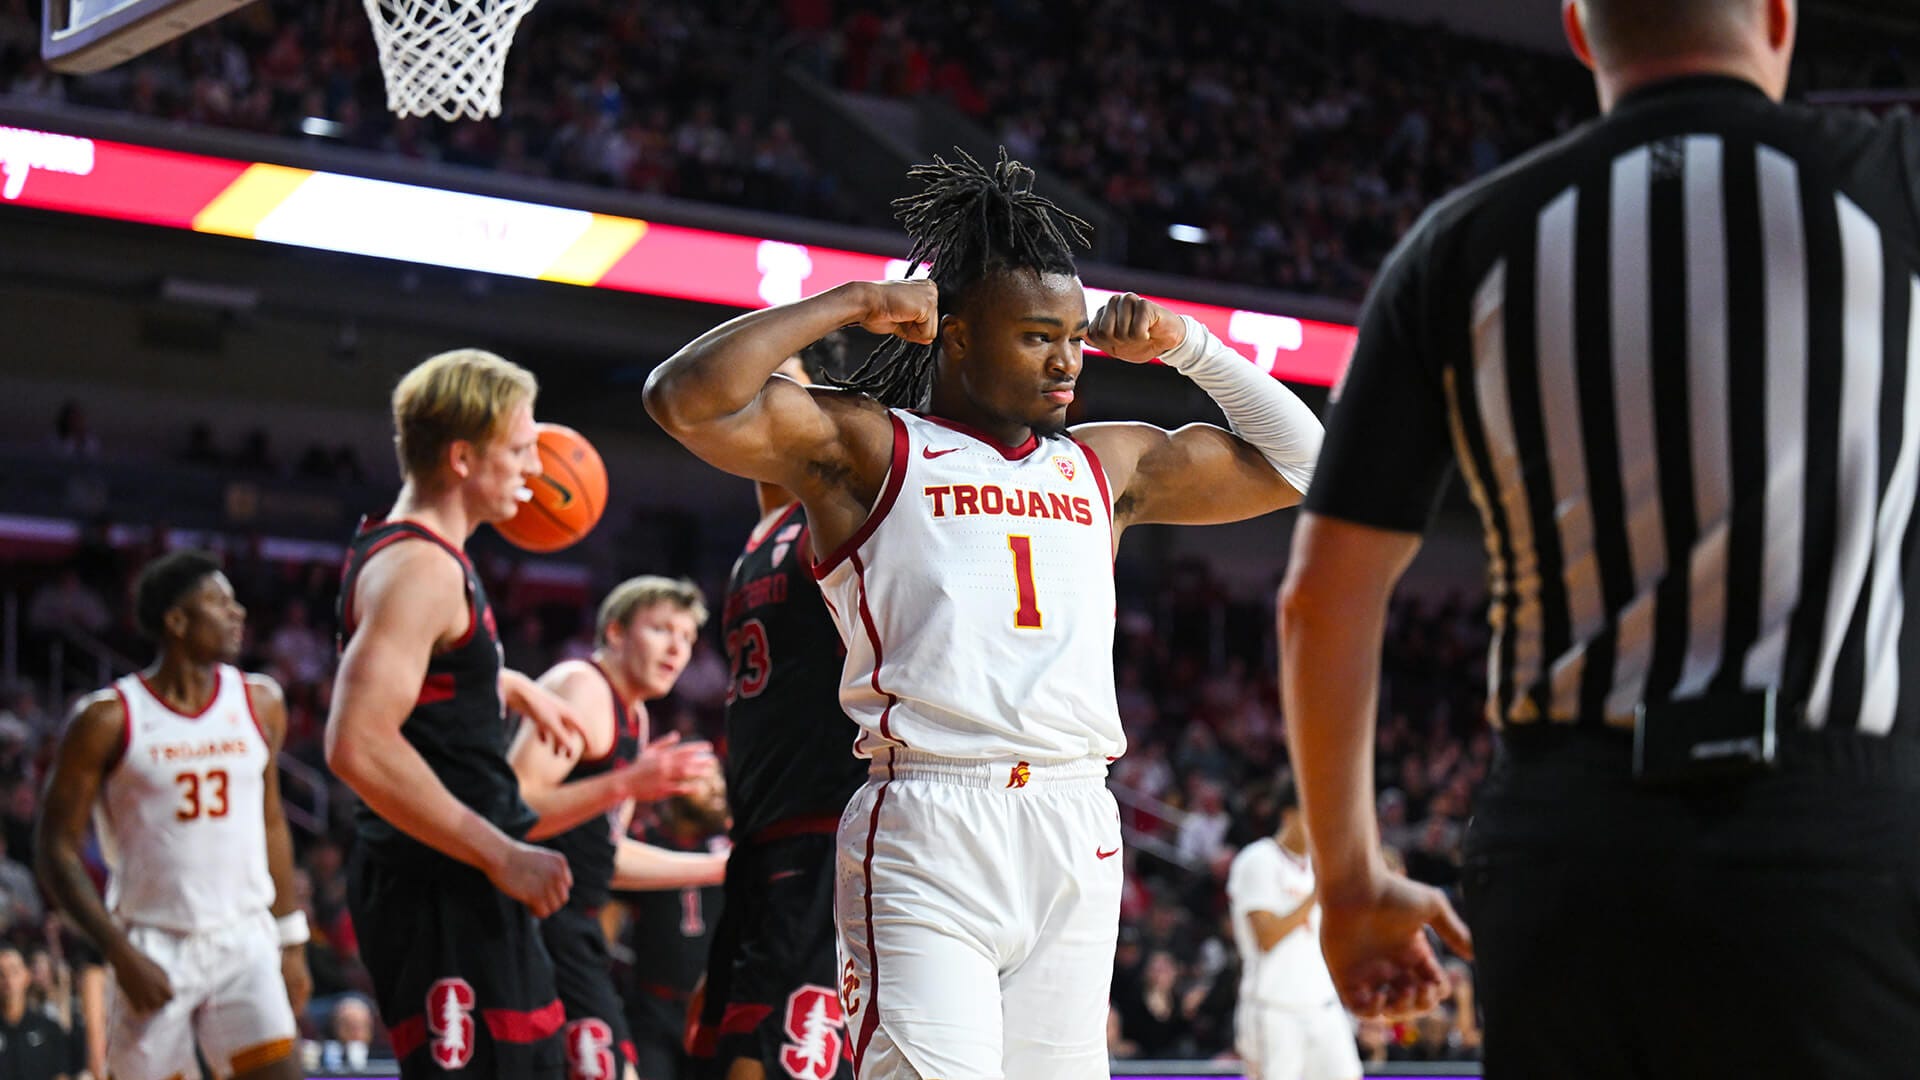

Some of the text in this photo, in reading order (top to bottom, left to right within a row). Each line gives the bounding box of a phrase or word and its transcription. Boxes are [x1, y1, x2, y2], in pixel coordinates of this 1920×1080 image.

[925, 485, 1093, 526] TROJANS
[1007, 533, 1043, 630] 1
[175, 769, 229, 822] 33
